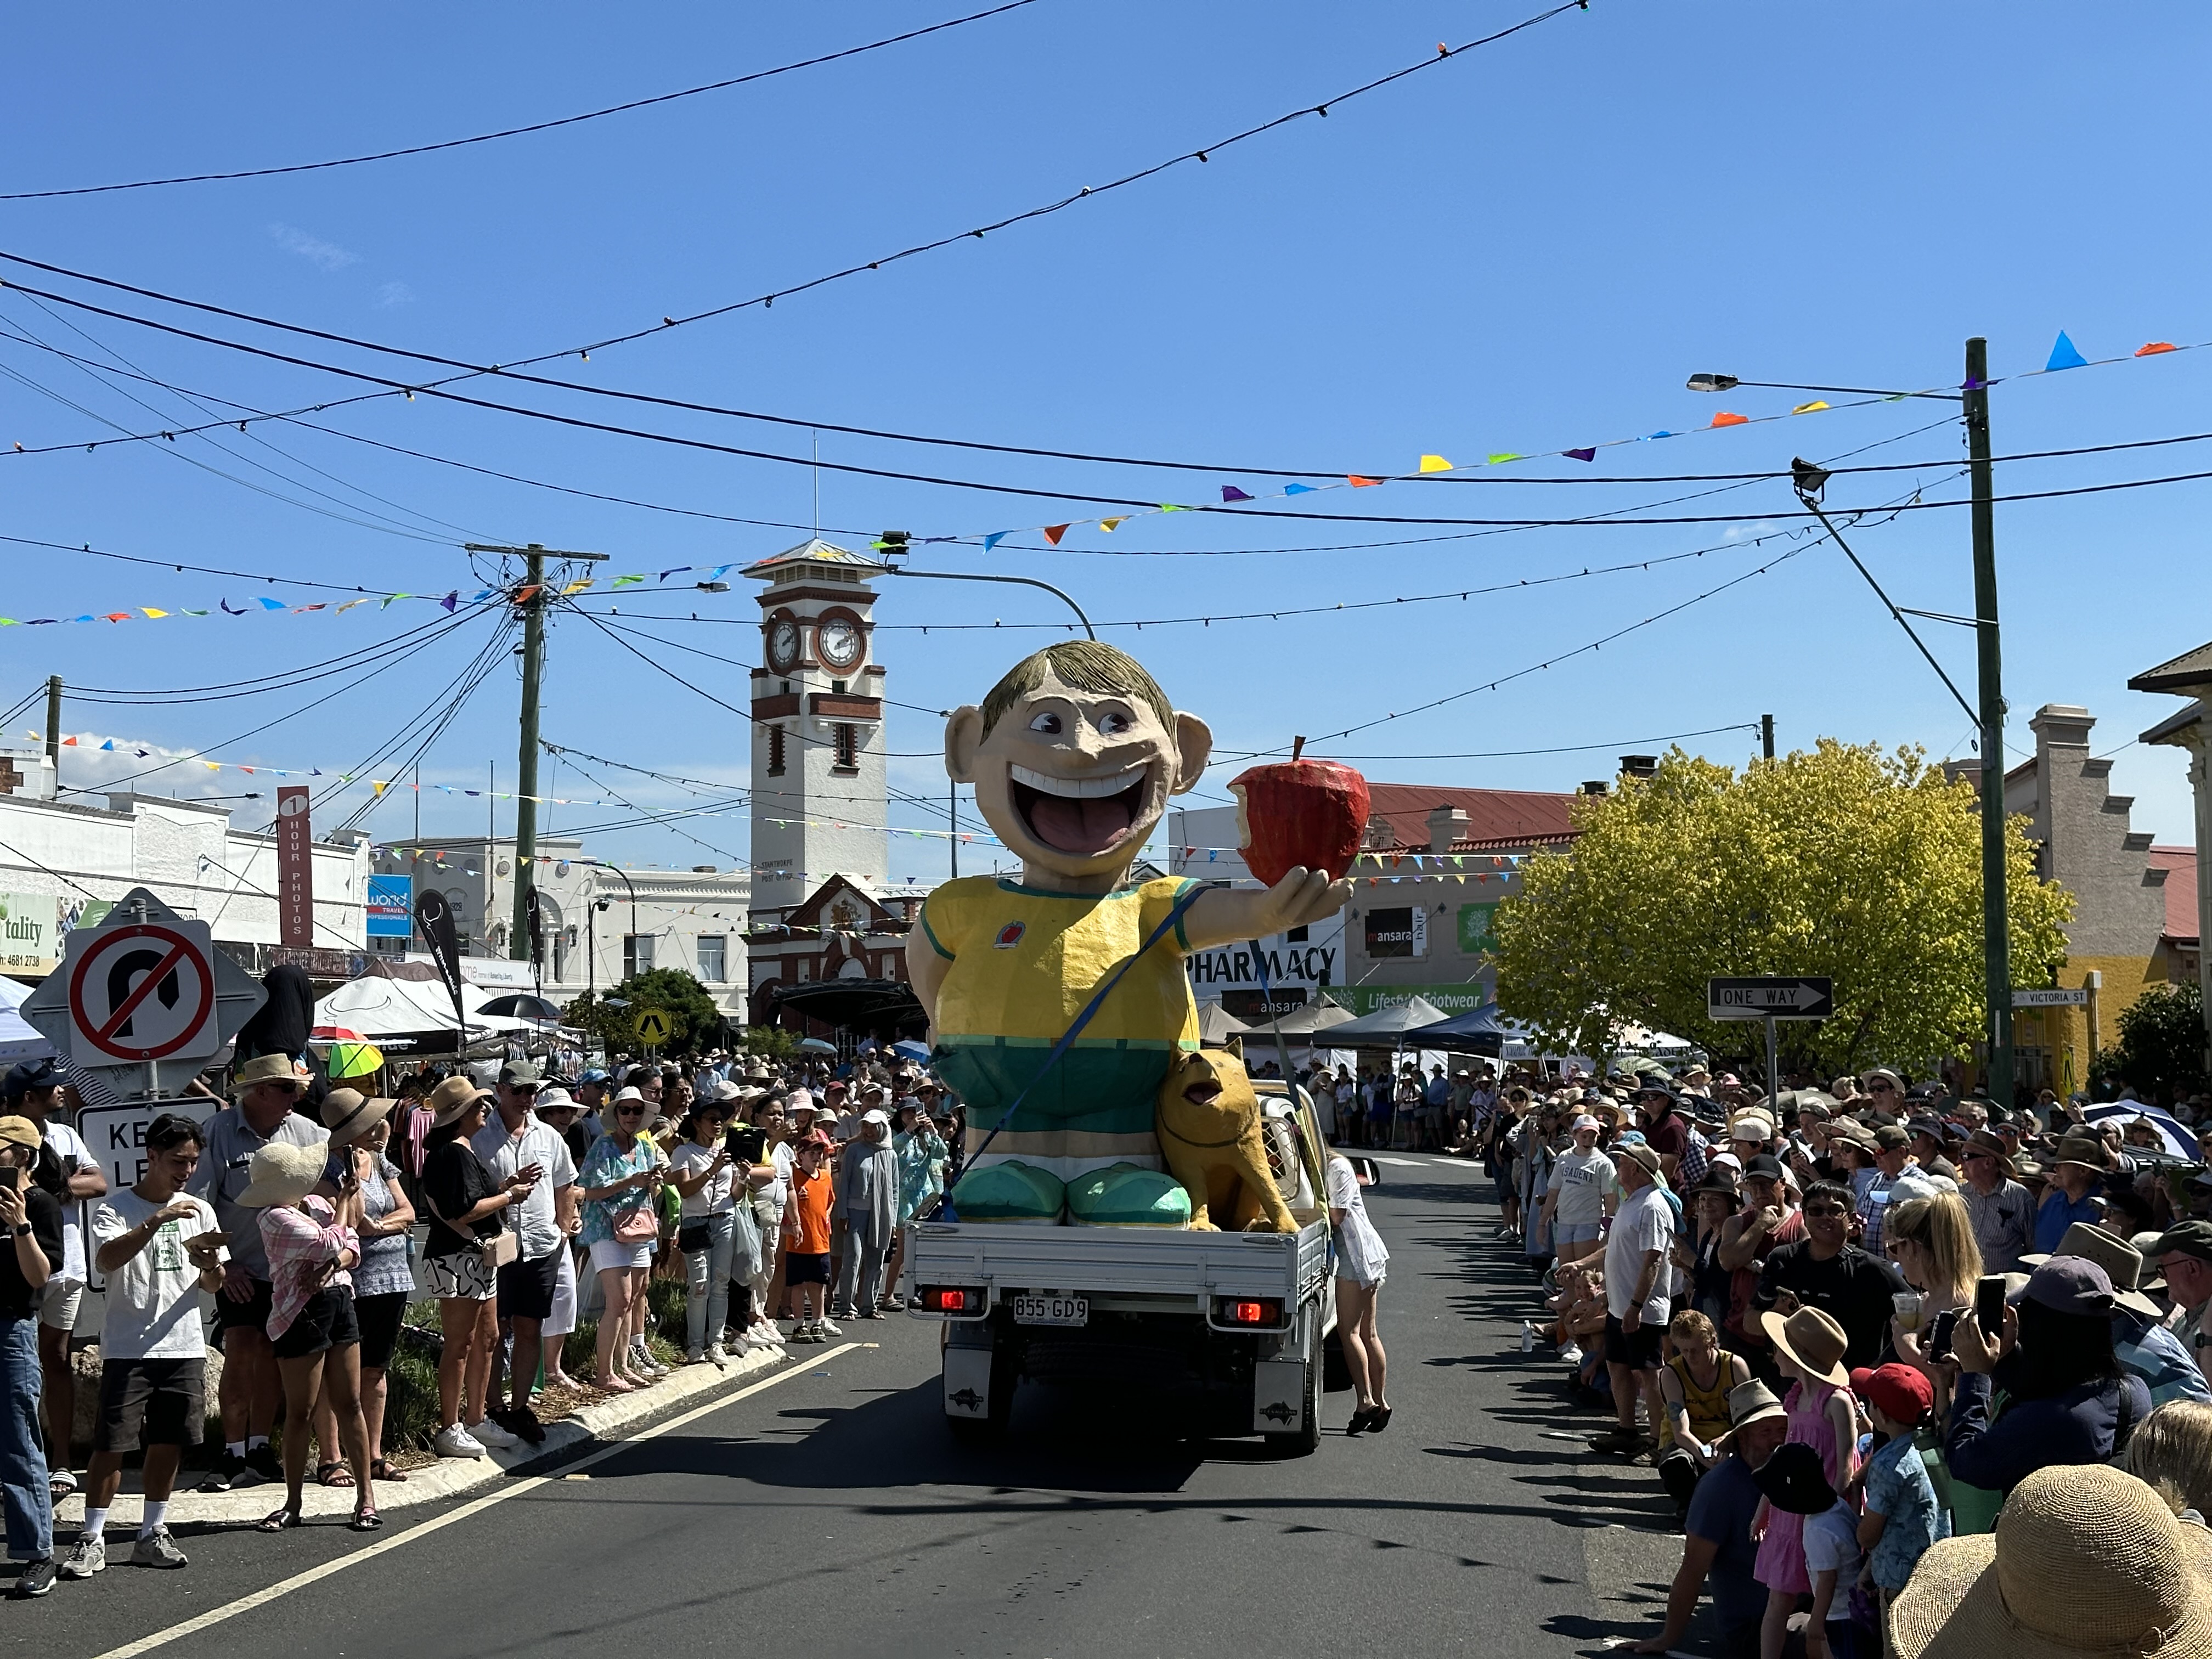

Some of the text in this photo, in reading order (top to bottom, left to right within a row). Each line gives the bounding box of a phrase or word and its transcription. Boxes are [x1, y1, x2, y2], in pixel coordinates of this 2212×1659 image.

[289, 797, 301, 934] 1 HOUR PHOTOS
[1368, 932, 1412, 942] mansara
[8, 955, 23, 966] 4681
[25, 955, 40, 967] 2738
[1724, 990, 1797, 1005] ONE WAY
[2029, 992, 2084, 1003] VICTORIA ST
[110, 1121, 149, 1150] KE
[115, 1159, 150, 1187] LE
